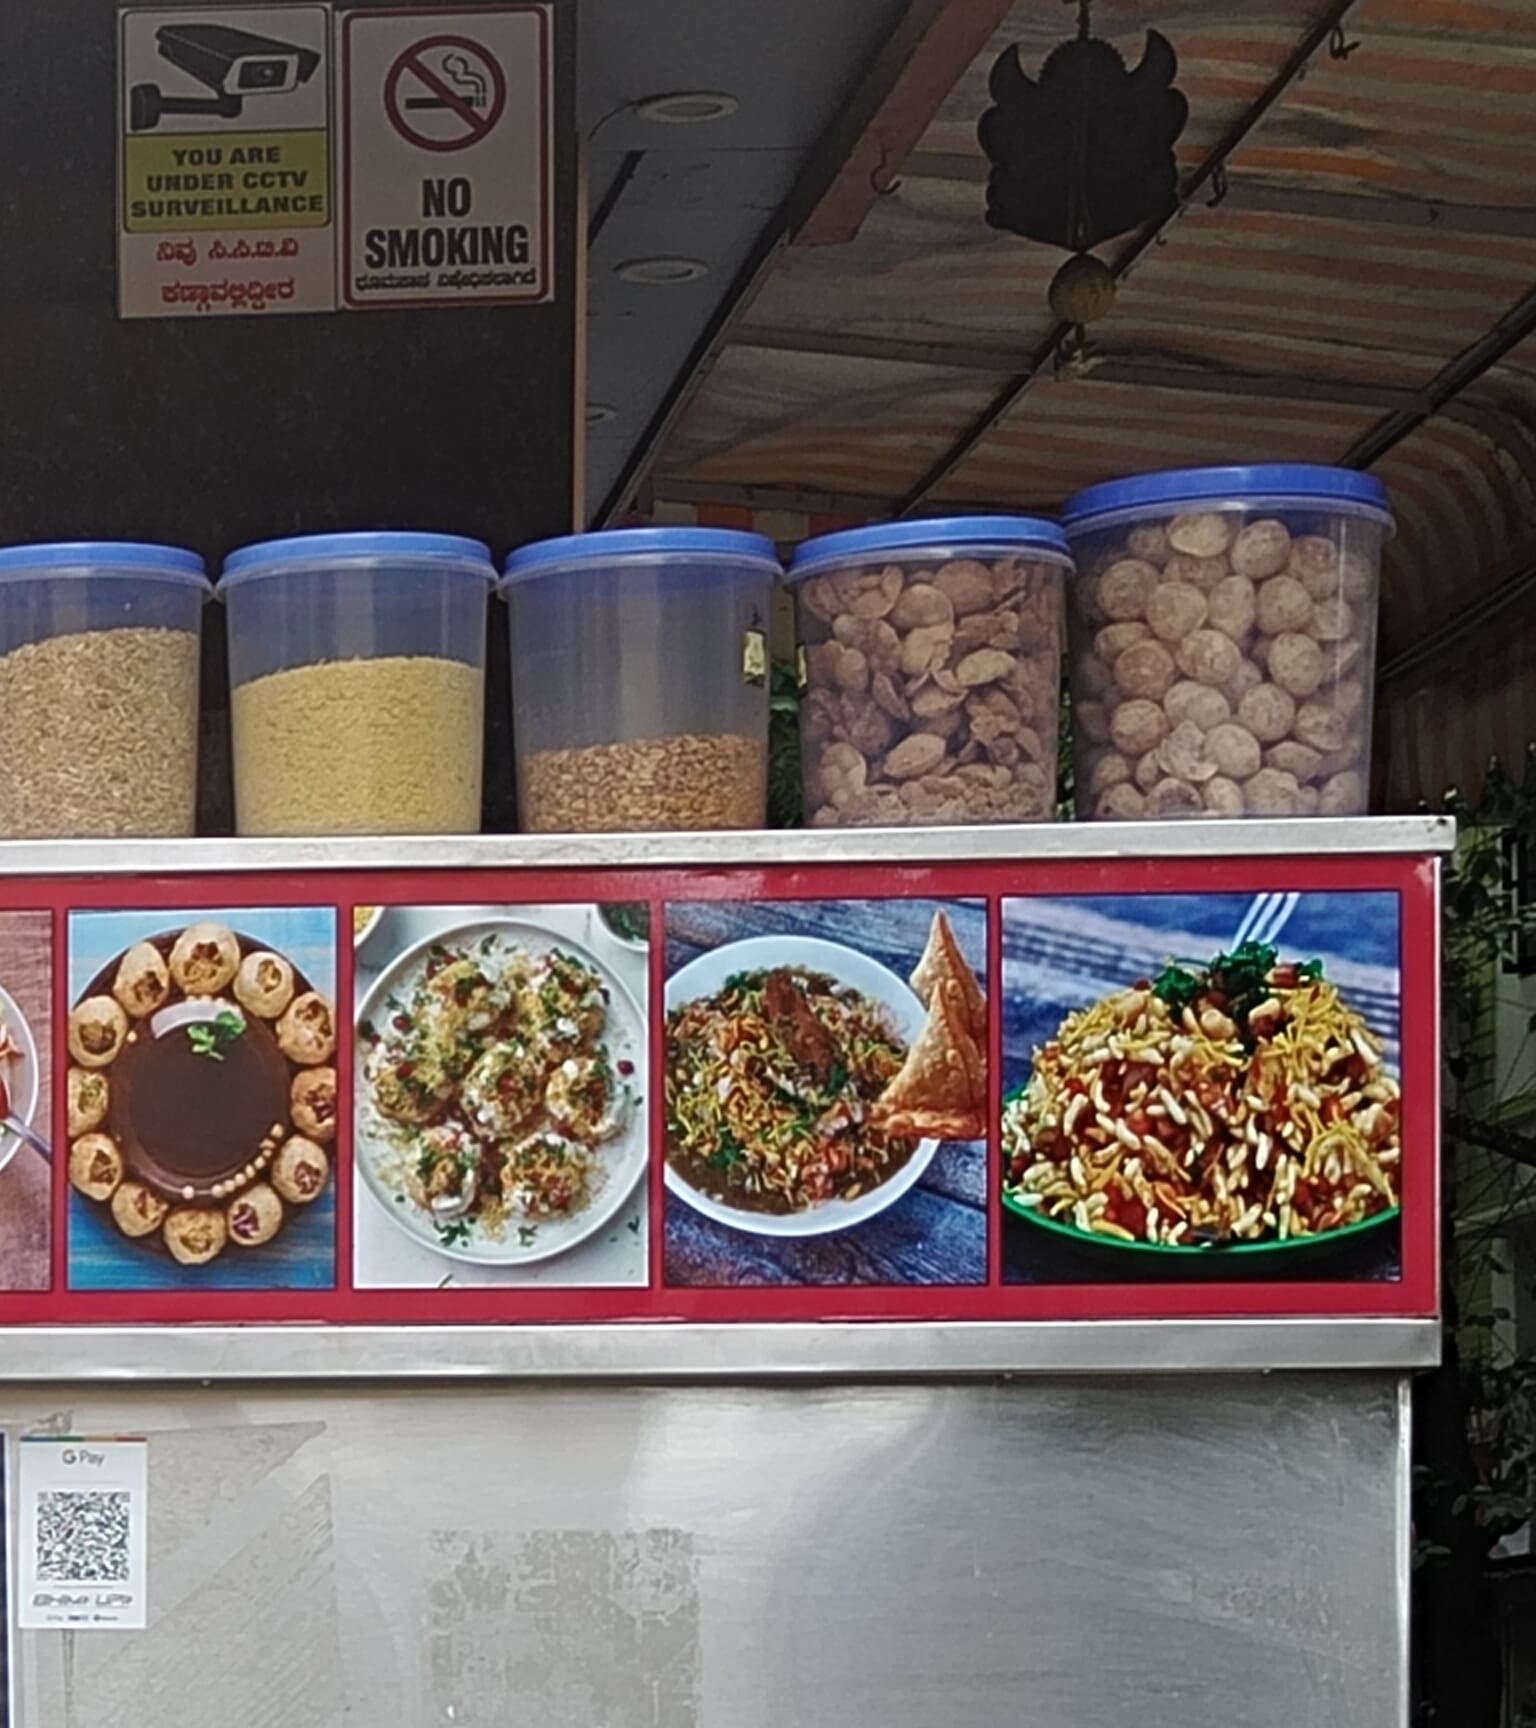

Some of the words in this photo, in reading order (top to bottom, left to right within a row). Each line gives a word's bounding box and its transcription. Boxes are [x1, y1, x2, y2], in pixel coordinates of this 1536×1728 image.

[171, 148, 222, 166] YOU
[229, 146, 281, 165] ARE
[146, 173, 234, 192] UNDER
[242, 170, 308, 189] CCTV
[131, 194, 323, 218] SURVEILLANCE
[422, 177, 471, 218] NO
[365, 225, 529, 269] SMOKING
[79, 1450, 105, 1468] Pay
